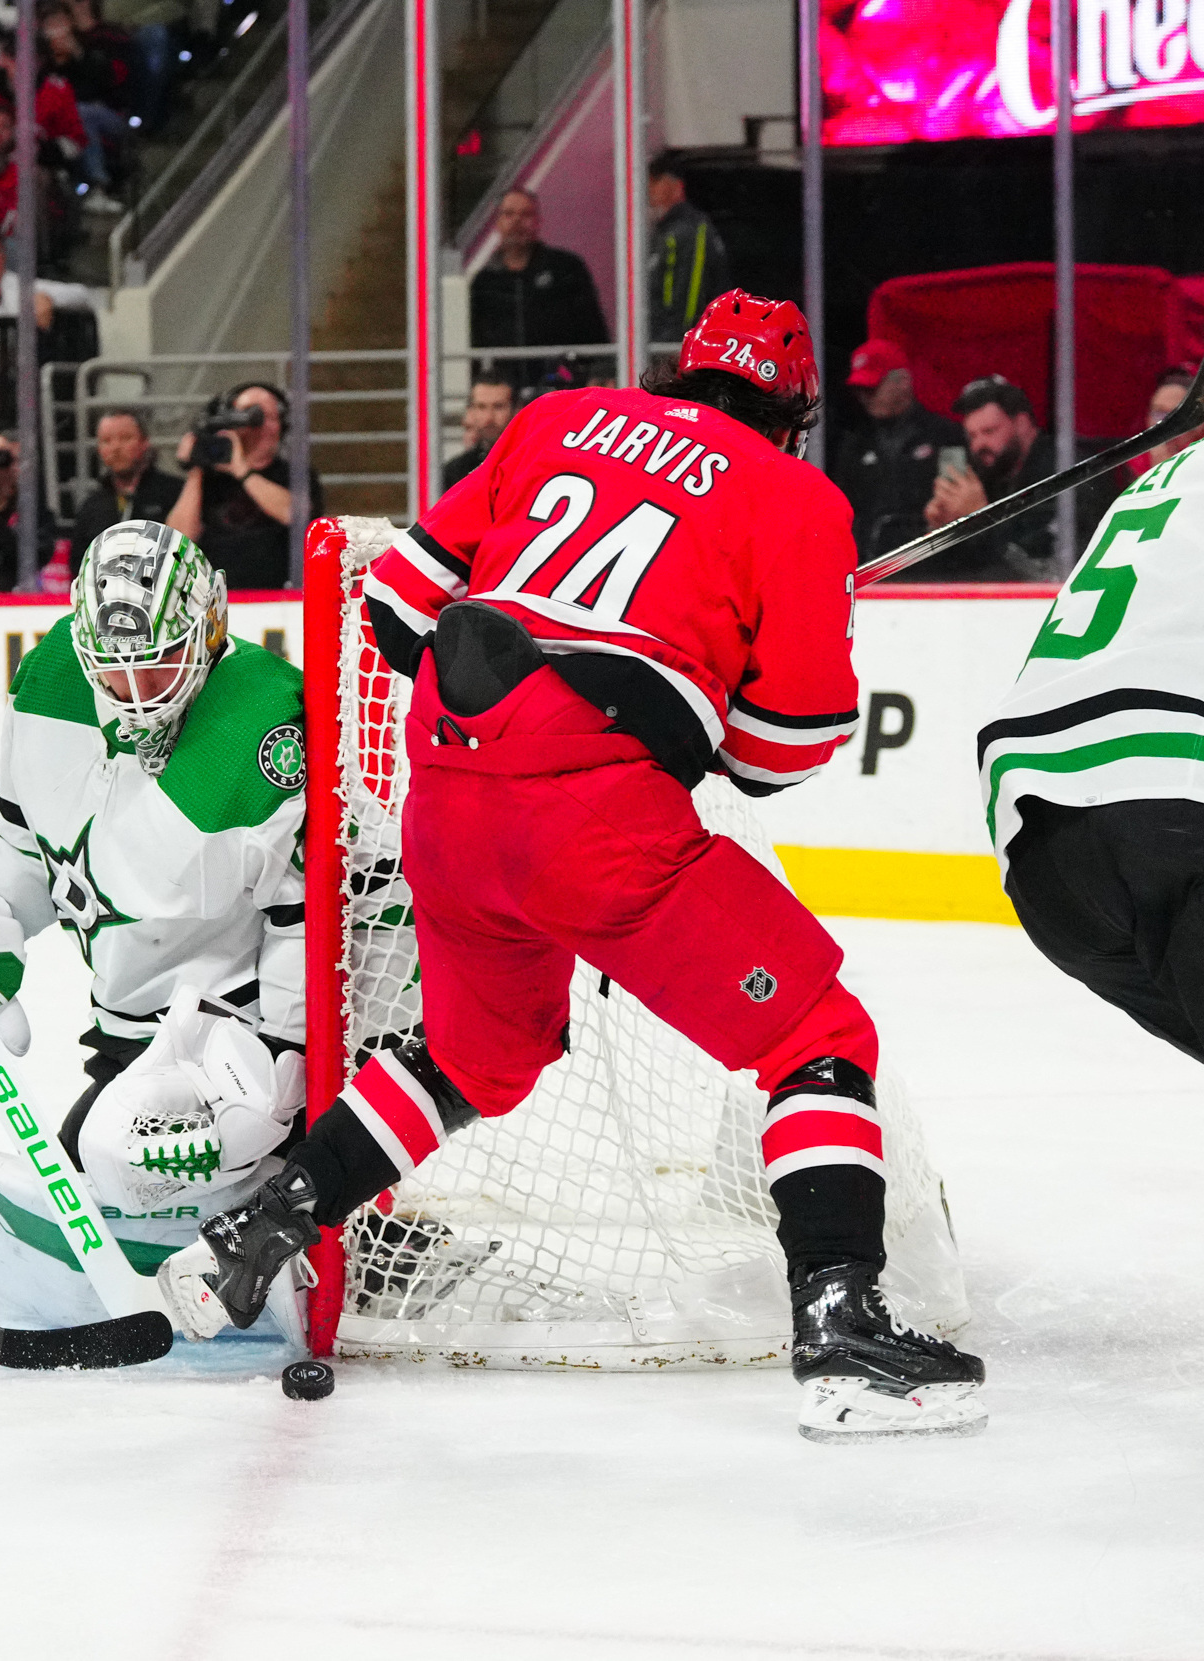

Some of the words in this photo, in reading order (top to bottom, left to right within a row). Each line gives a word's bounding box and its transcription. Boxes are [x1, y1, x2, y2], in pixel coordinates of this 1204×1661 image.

[719, 337, 753, 368] 24
[562, 408, 730, 497] JARVIS
[491, 472, 681, 624] 24
